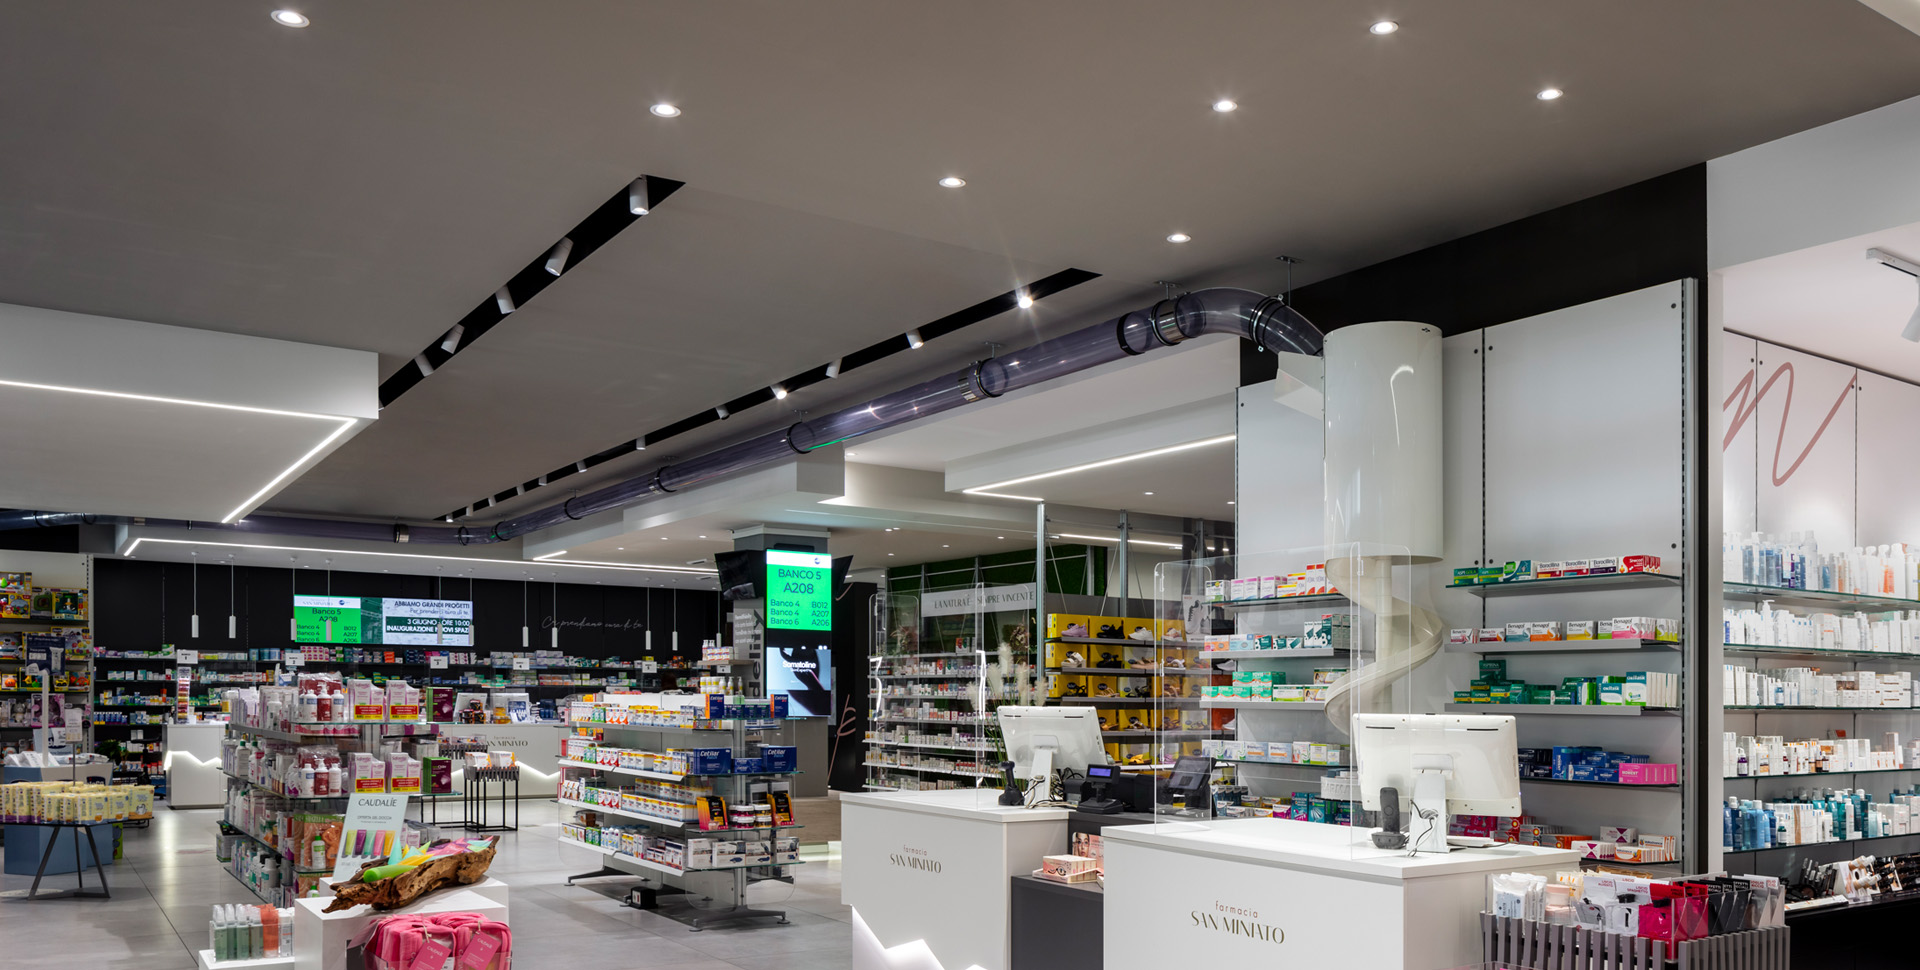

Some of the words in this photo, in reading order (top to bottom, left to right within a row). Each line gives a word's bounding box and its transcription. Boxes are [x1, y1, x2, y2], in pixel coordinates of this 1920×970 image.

[778, 569, 814, 580] BANCO
[815, 571, 822, 580] 5
[783, 582, 814, 594] A208
[1002, 591, 1034, 602] VINCENTE
[811, 610, 829, 618] A207
[782, 661, 816, 669] Somatoline
[903, 844, 927, 856] farmacia
[890, 853, 906, 867] SAN
[907, 856, 942, 873] MINIATO
[1216, 900, 1258, 918] farmacia
[1191, 910, 1218, 930] SAN
[1223, 916, 1284, 944] MINIATO
